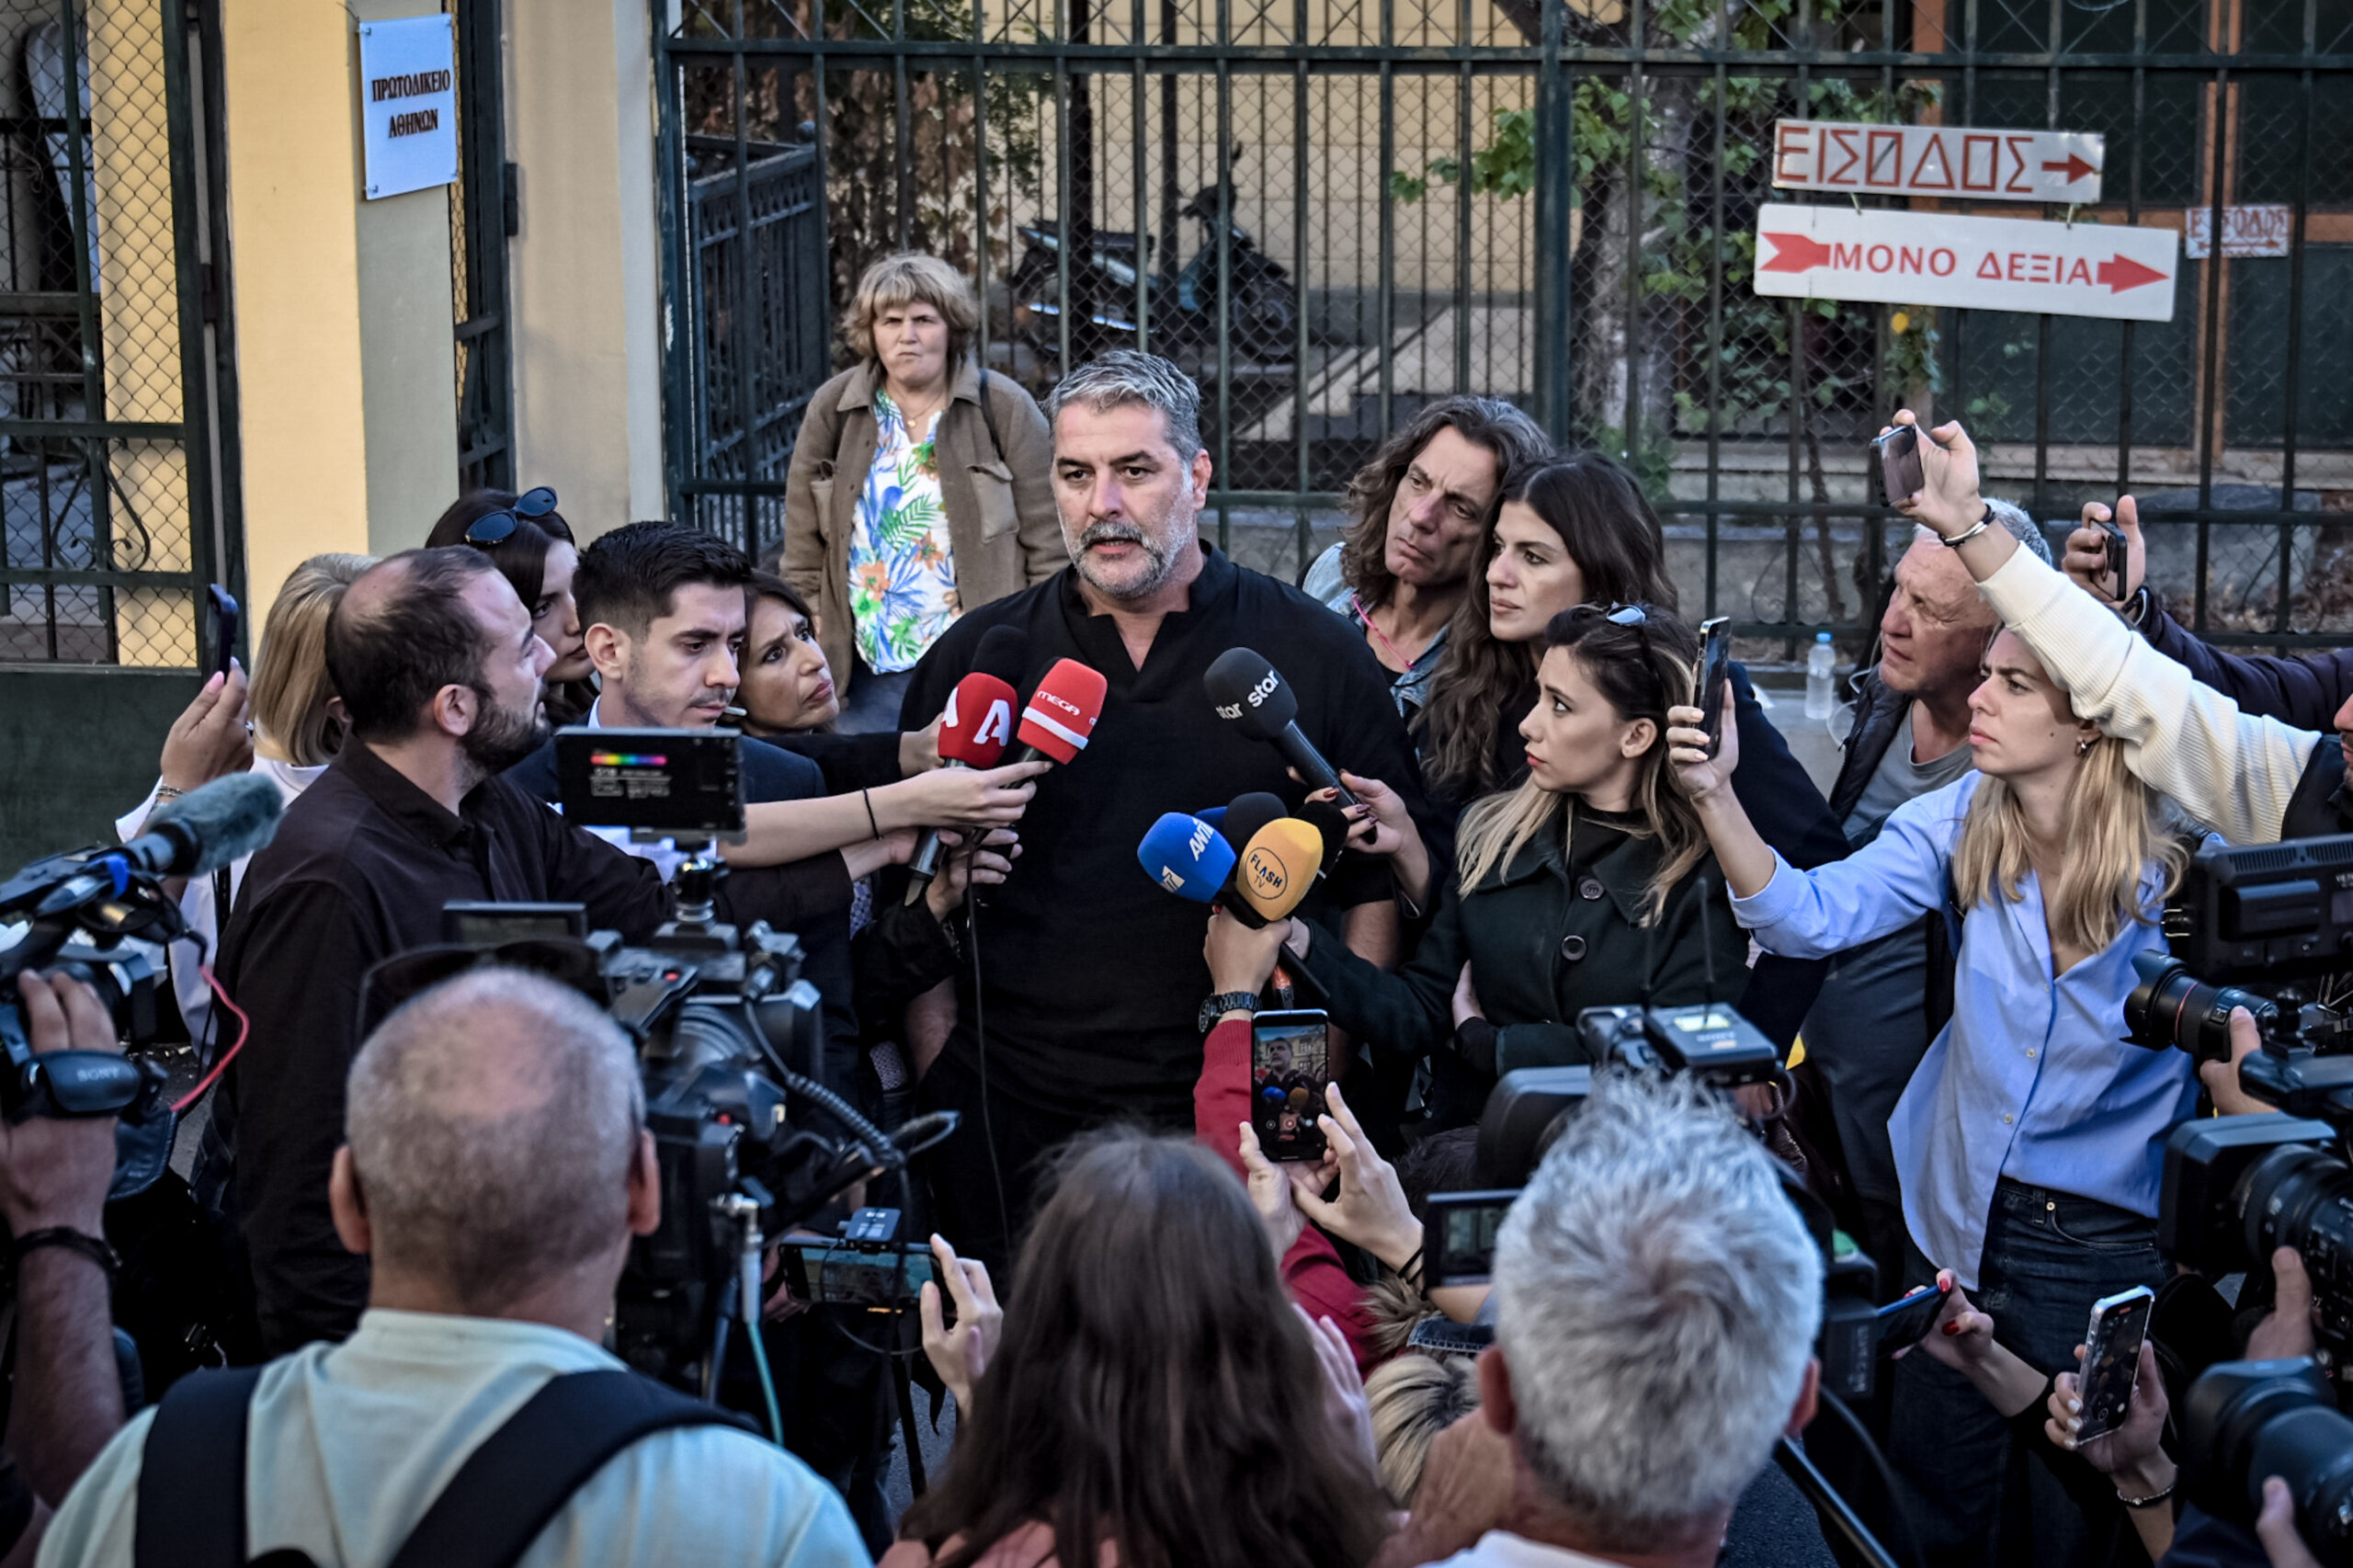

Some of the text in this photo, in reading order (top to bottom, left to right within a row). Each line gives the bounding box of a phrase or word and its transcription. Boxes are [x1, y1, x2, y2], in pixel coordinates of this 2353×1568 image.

[372, 69, 450, 101] ΠΡΩΤΟΔΙΚΕΙΟ
[389, 108, 438, 138] ΑΘΗΝΩΝ
[1778, 126, 2034, 193] ΕΙΣΟΔΟΣ
[2191, 207, 2288, 238] ΕΣΟΔΟΣ
[1833, 242, 2094, 287] ΜΟΝΟ ΔΕΞΙΑ
[1036, 690, 1081, 716] MEGA
[1247, 669, 1279, 708] star
[1250, 854, 1283, 889] FLASH
[1254, 874, 1266, 888] TV
